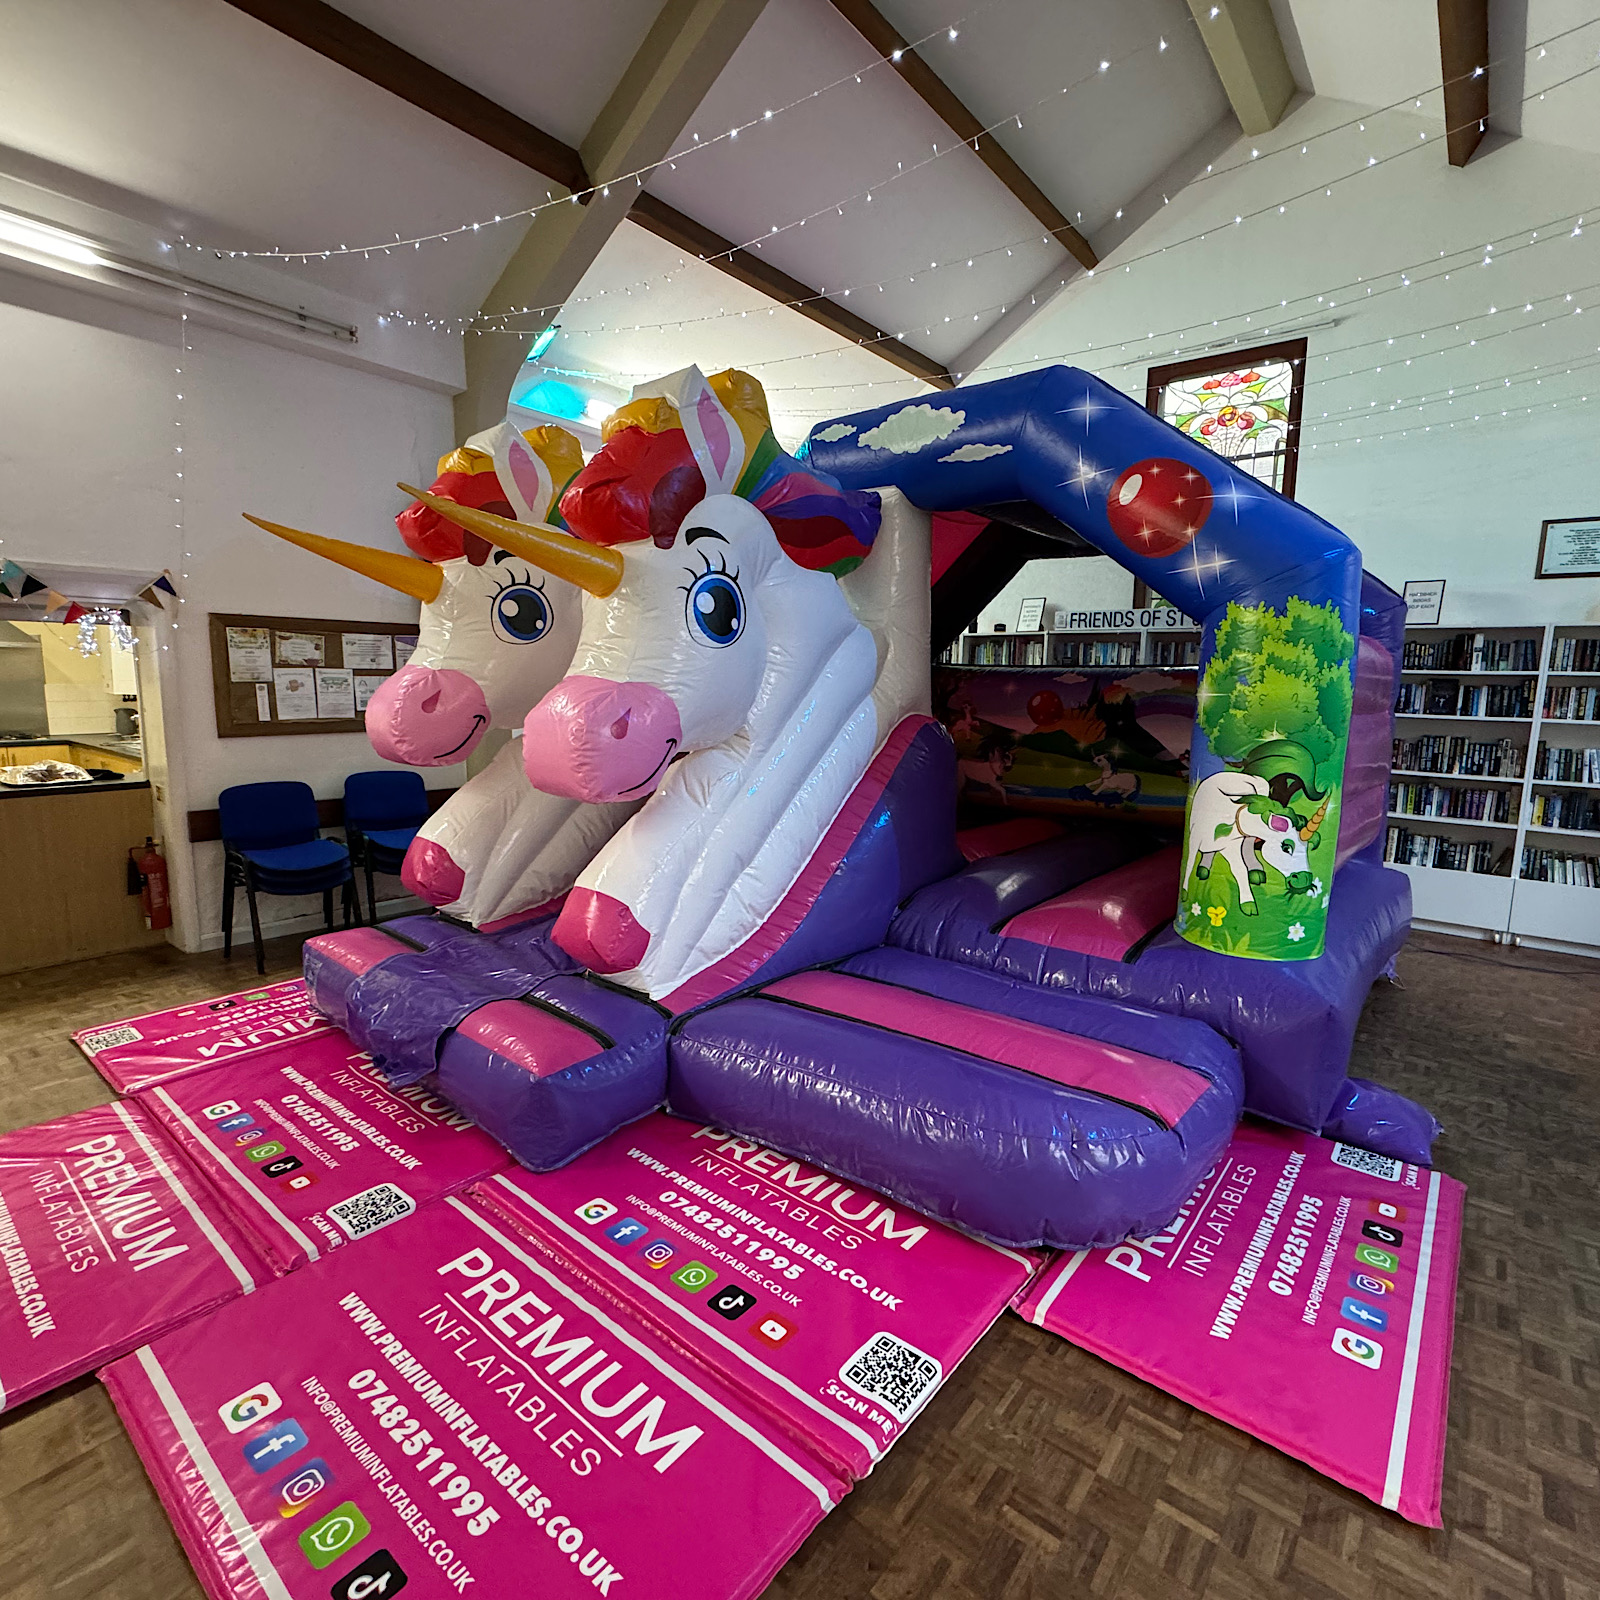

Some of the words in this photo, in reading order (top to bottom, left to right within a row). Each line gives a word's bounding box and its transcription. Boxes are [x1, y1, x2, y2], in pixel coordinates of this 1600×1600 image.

[1069, 610, 1135, 628] FRIENDS
[1140, 609, 1162, 627] OF
[280, 1065, 423, 1171] WWW.PREMIUMINFLATABLES.CO.UK
[281, 1094, 361, 1152] 07482511995
[329, 1069, 426, 1134] INFLATABLES
[29, 1169, 100, 1273] INFLATABLES
[66, 1134, 190, 1273] PREMIUM
[308, 1215, 333, 1234] SCAN
[324, 1229, 343, 1248] ME
[626, 1148, 904, 1311] WWW.PREMIUMINFLATABLES.CO.UK
[658, 1190, 806, 1281] 07482511995
[691, 1125, 929, 1250] PREMIUM
[691, 1154, 862, 1250] INFLATABLES
[1182, 1164, 1257, 1277] INFLATABLES
[625, 1194, 803, 1308] INFO@PREMIUMINFLATABLES.CO.UK
[1209, 1150, 1306, 1340] WWW.PREMIUMINFLATABLES.CO.UK
[1268, 1194, 1323, 1296] 07482511995
[1301, 1195, 1352, 1326] INFO@PREMIUMINFLATABLES.CO.UK
[418, 1303, 602, 1477] INFLATABLES
[436, 1247, 704, 1474] PREMIUM
[826, 1384, 869, 1415] SCAN
[867, 1409, 893, 1435] ME
[300, 1375, 477, 1595] INFO@PREMIUMINFLATABLES.CO.UK
[338, 1291, 625, 1598] WWW.PREMIUMINFLATABLES.CO.UK
[347, 1368, 502, 1537] 07482511995
